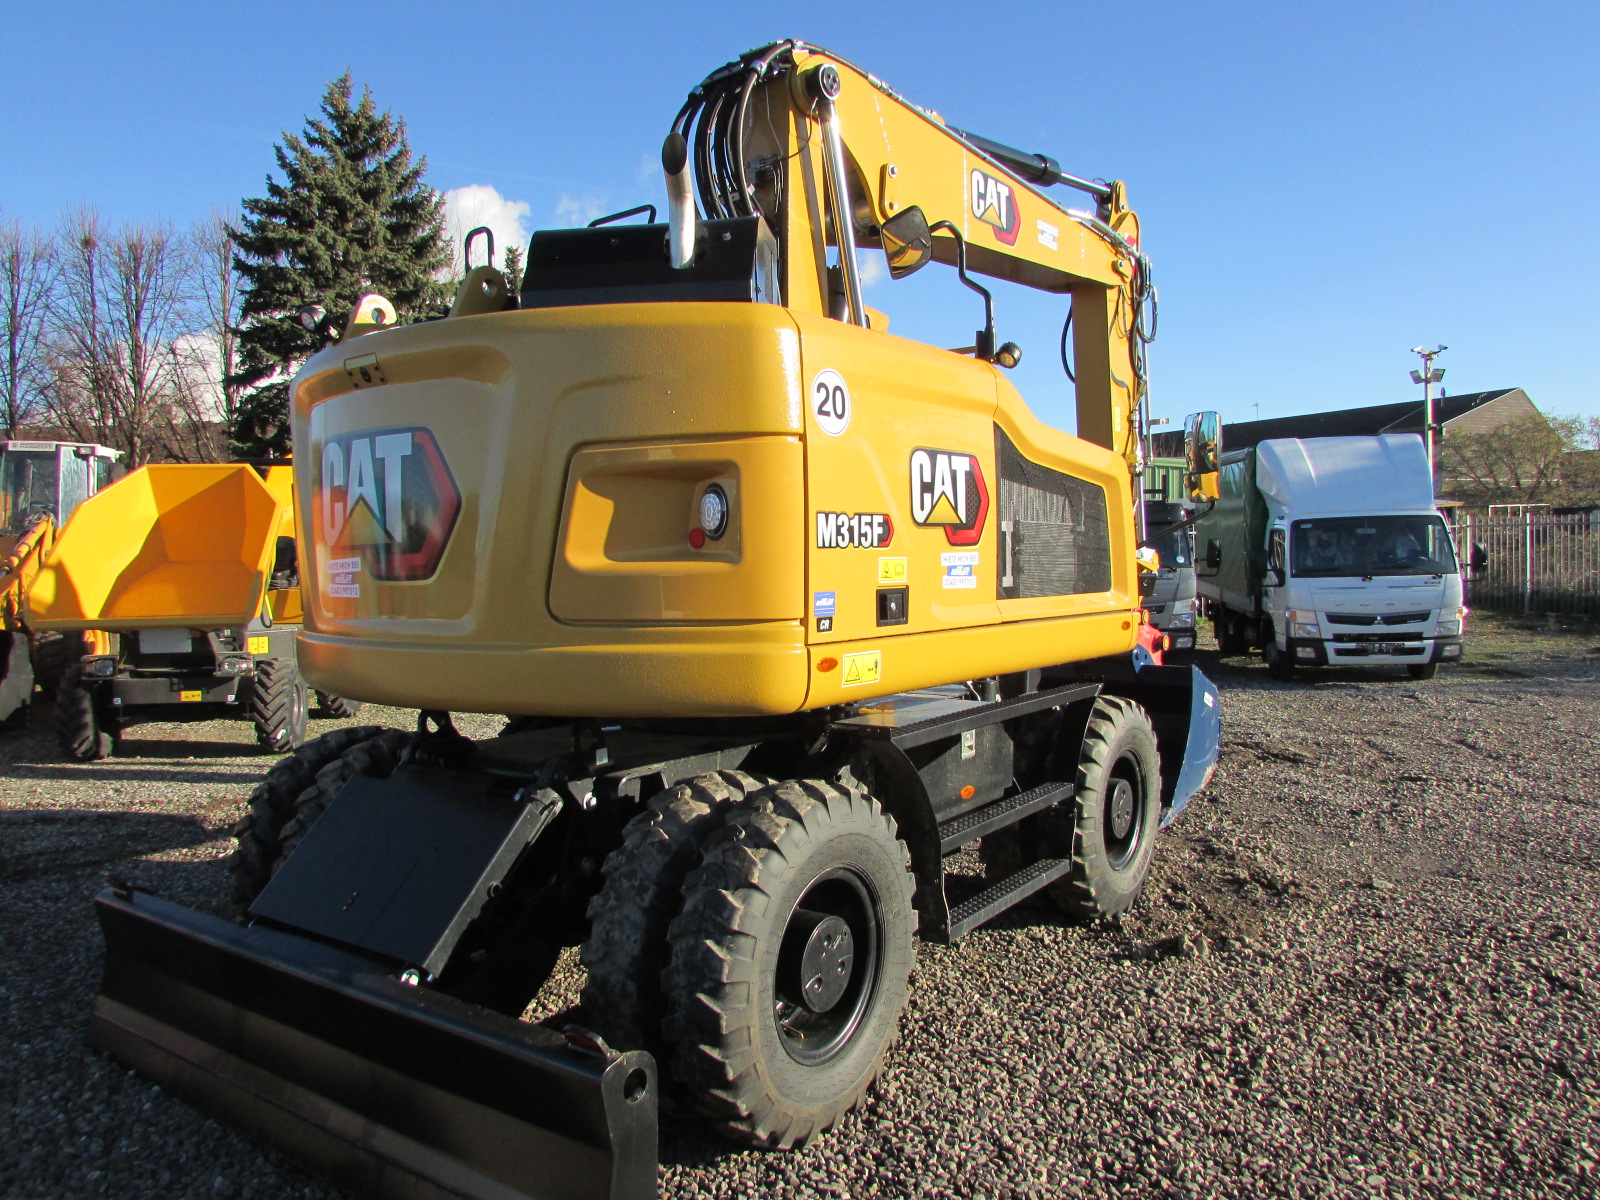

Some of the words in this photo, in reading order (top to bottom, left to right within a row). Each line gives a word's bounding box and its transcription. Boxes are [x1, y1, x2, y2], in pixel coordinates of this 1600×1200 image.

[971, 169, 1009, 230] CAT
[816, 382, 846, 420] 20
[322, 432, 412, 546] CAT
[911, 450, 970, 523] CAT
[817, 512, 884, 548] M315F
[820, 619, 830, 630] CR
